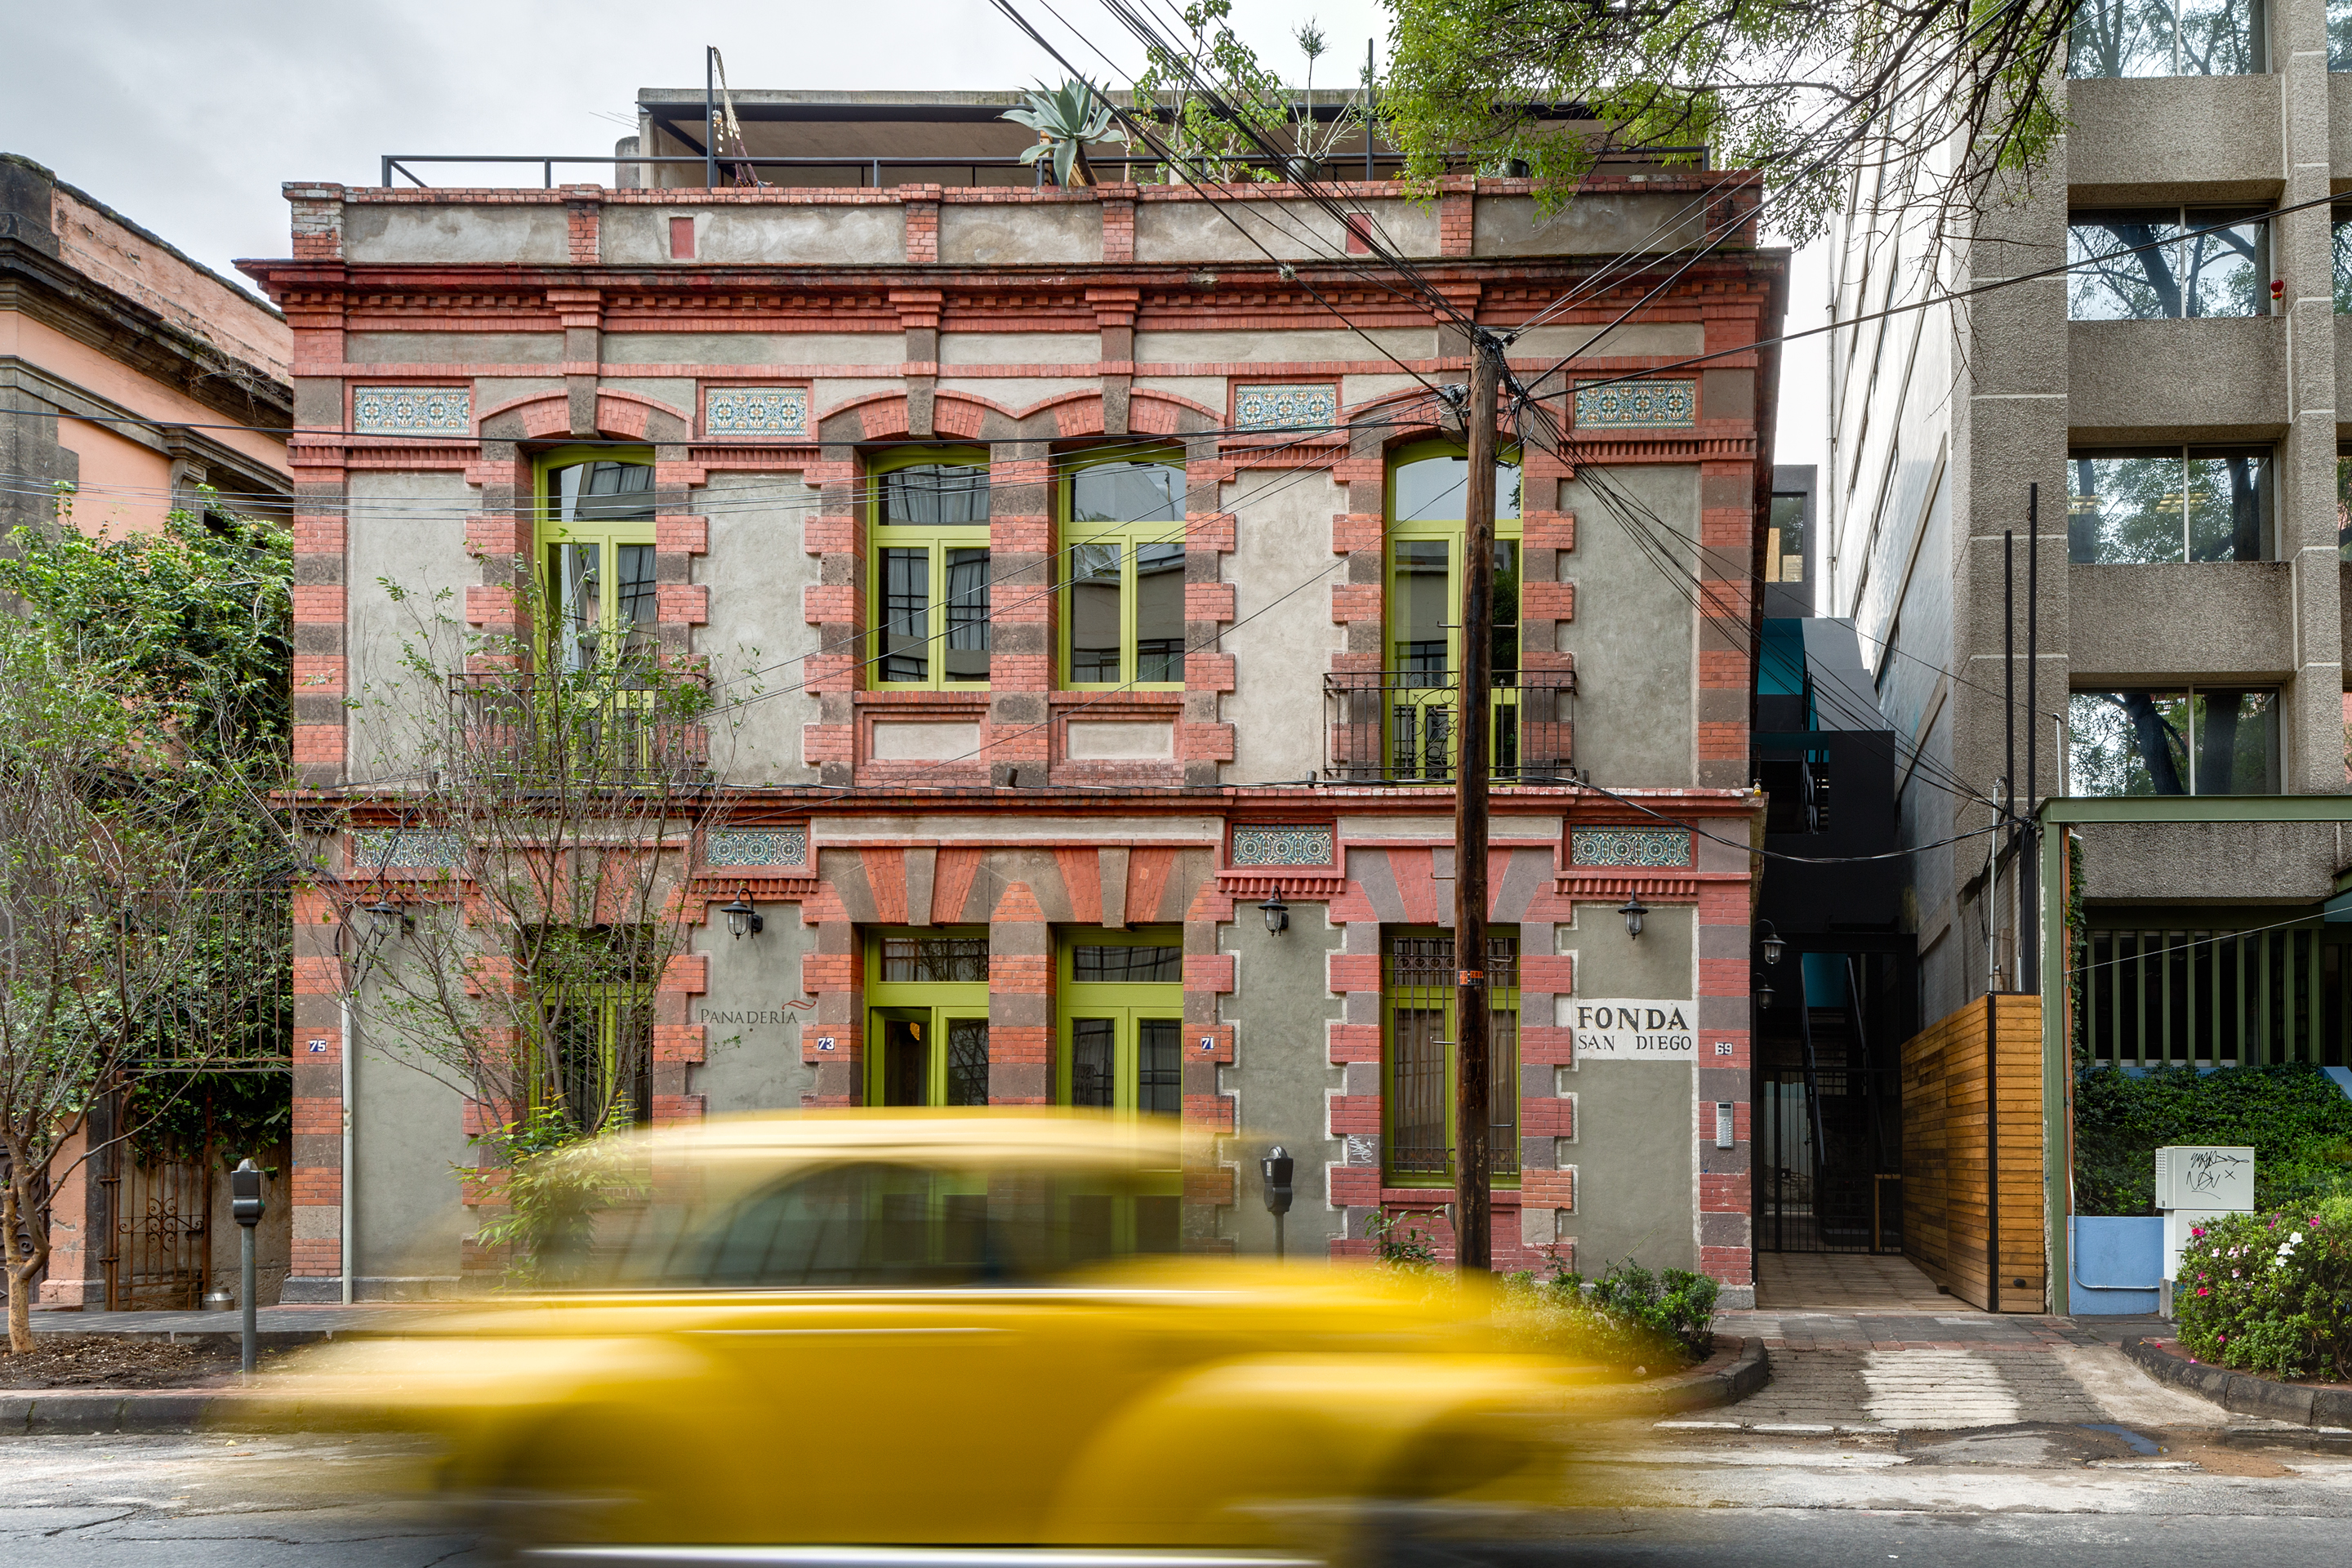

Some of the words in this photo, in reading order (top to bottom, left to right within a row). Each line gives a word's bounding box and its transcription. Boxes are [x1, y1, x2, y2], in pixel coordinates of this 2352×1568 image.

[1577, 1006, 1690, 1034] FONDA
[310, 1040, 326, 1052] 75
[818, 1037, 835, 1050] 73
[1201, 1037, 1214, 1049] 71
[1578, 1035, 1615, 1052] SAN
[1636, 1036, 1691, 1051] DIEGO
[1716, 1042, 1733, 1054] 69
